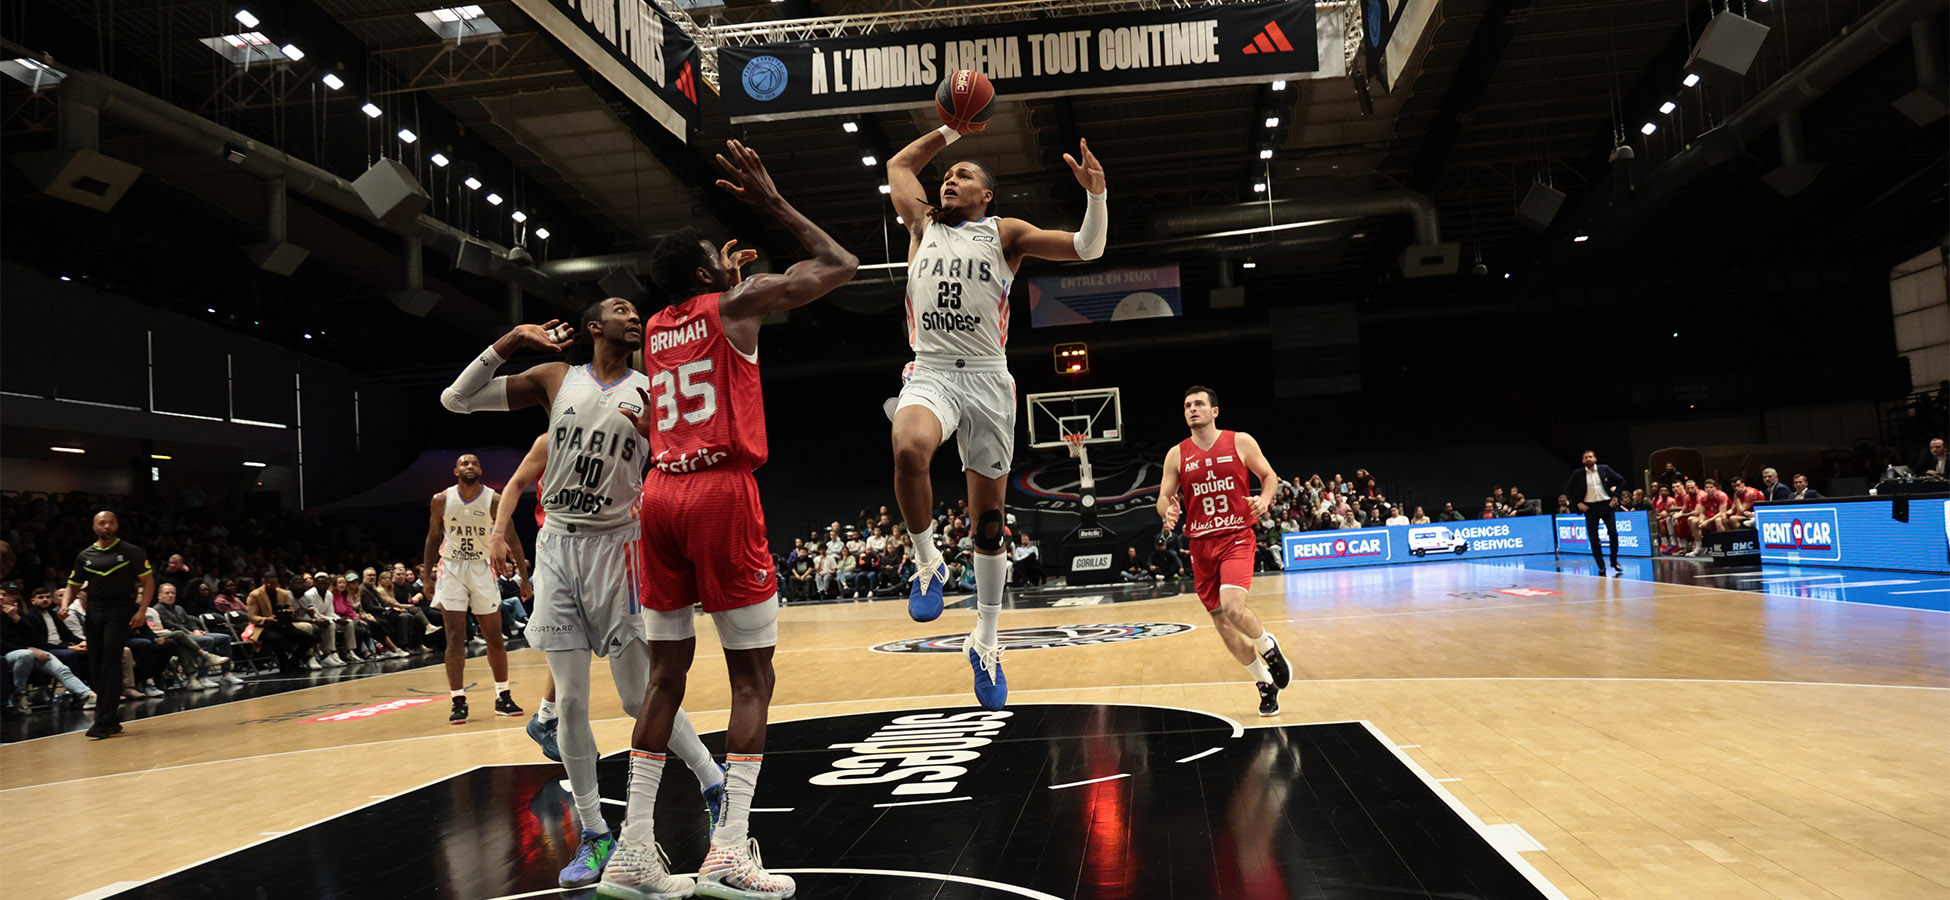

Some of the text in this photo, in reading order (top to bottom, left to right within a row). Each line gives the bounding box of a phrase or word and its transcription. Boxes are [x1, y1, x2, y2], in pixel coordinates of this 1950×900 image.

[811, 20, 1219, 95] À L'ADIDAS ARENA TOUT CONTINUE
[918, 258, 991, 282] PARIS
[1061, 276, 1105, 289] ENTREZ
[1107, 273, 1121, 283] EN
[1124, 271, 1151, 283] JEUX
[938, 281, 962, 309] 23
[922, 311, 975, 334] snipes
[650, 318, 708, 355] BRIMAH
[651, 358, 717, 433] 35
[556, 427, 636, 462] PARIS
[575, 455, 604, 489] 40
[1191, 476, 1235, 497] BOURG
[1202, 494, 1229, 516] 83
[450, 526, 485, 536] PARIS
[1762, 522, 1791, 544] RENT
[1803, 522, 1832, 544] CAR
[461, 538, 474, 551] 25
[1294, 542, 1332, 557] RENT
[1348, 539, 1381, 554] CAR
[1473, 537, 1524, 552] SERVICE
[1732, 541, 1754, 551] RMC
[1076, 557, 1107, 568] GORILLAS
[809, 711, 1014, 786] snipes
